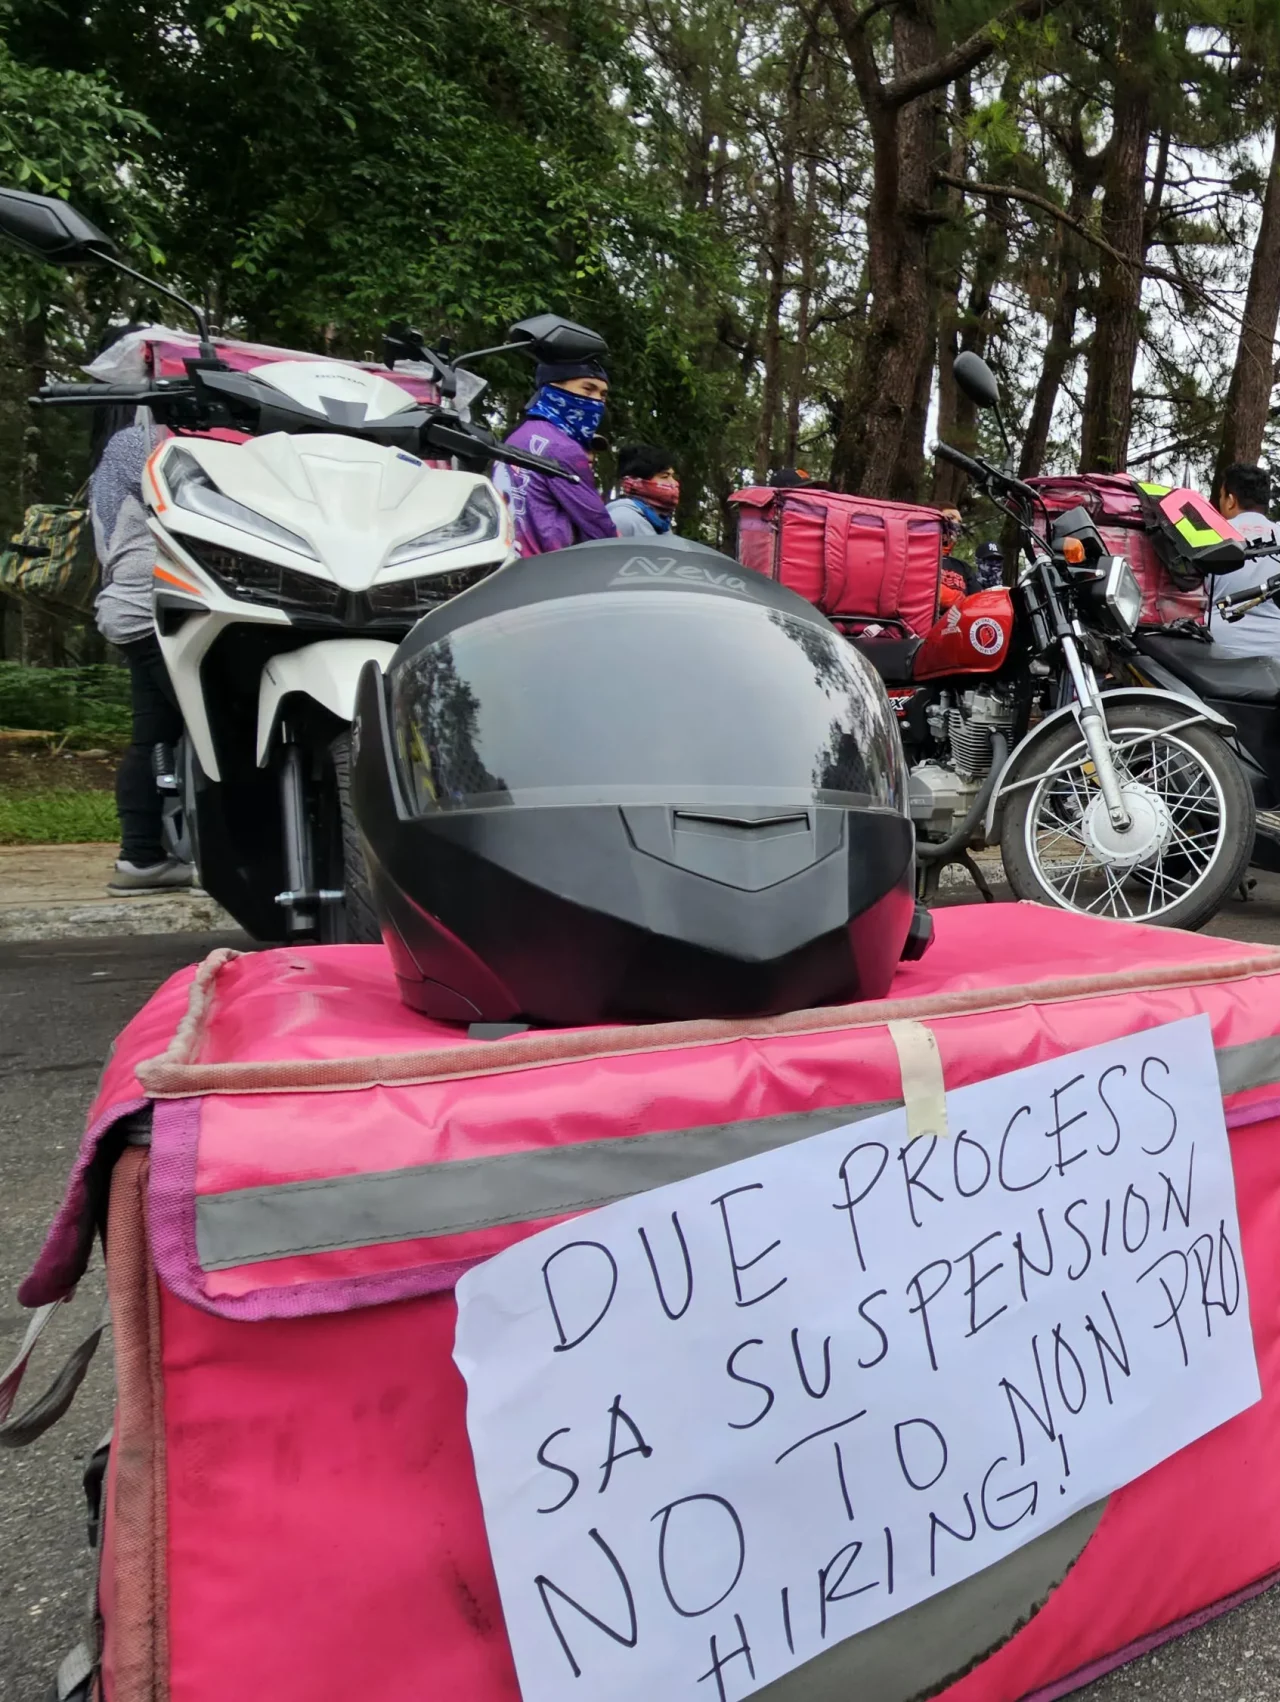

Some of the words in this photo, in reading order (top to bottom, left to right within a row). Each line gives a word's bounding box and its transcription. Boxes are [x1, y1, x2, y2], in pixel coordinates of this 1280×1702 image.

[535, 1395, 653, 1516] SA
[727, 1141, 1197, 1431] SUSPENSION
[541, 1182, 788, 1353] DUE
[832, 1055, 1178, 1272] PROCESS
[533, 1493, 747, 1679] NO
[775, 1409, 949, 1522] TO
[998, 1291, 1132, 1465] NON
[1135, 1219, 1240, 1368] PRO
